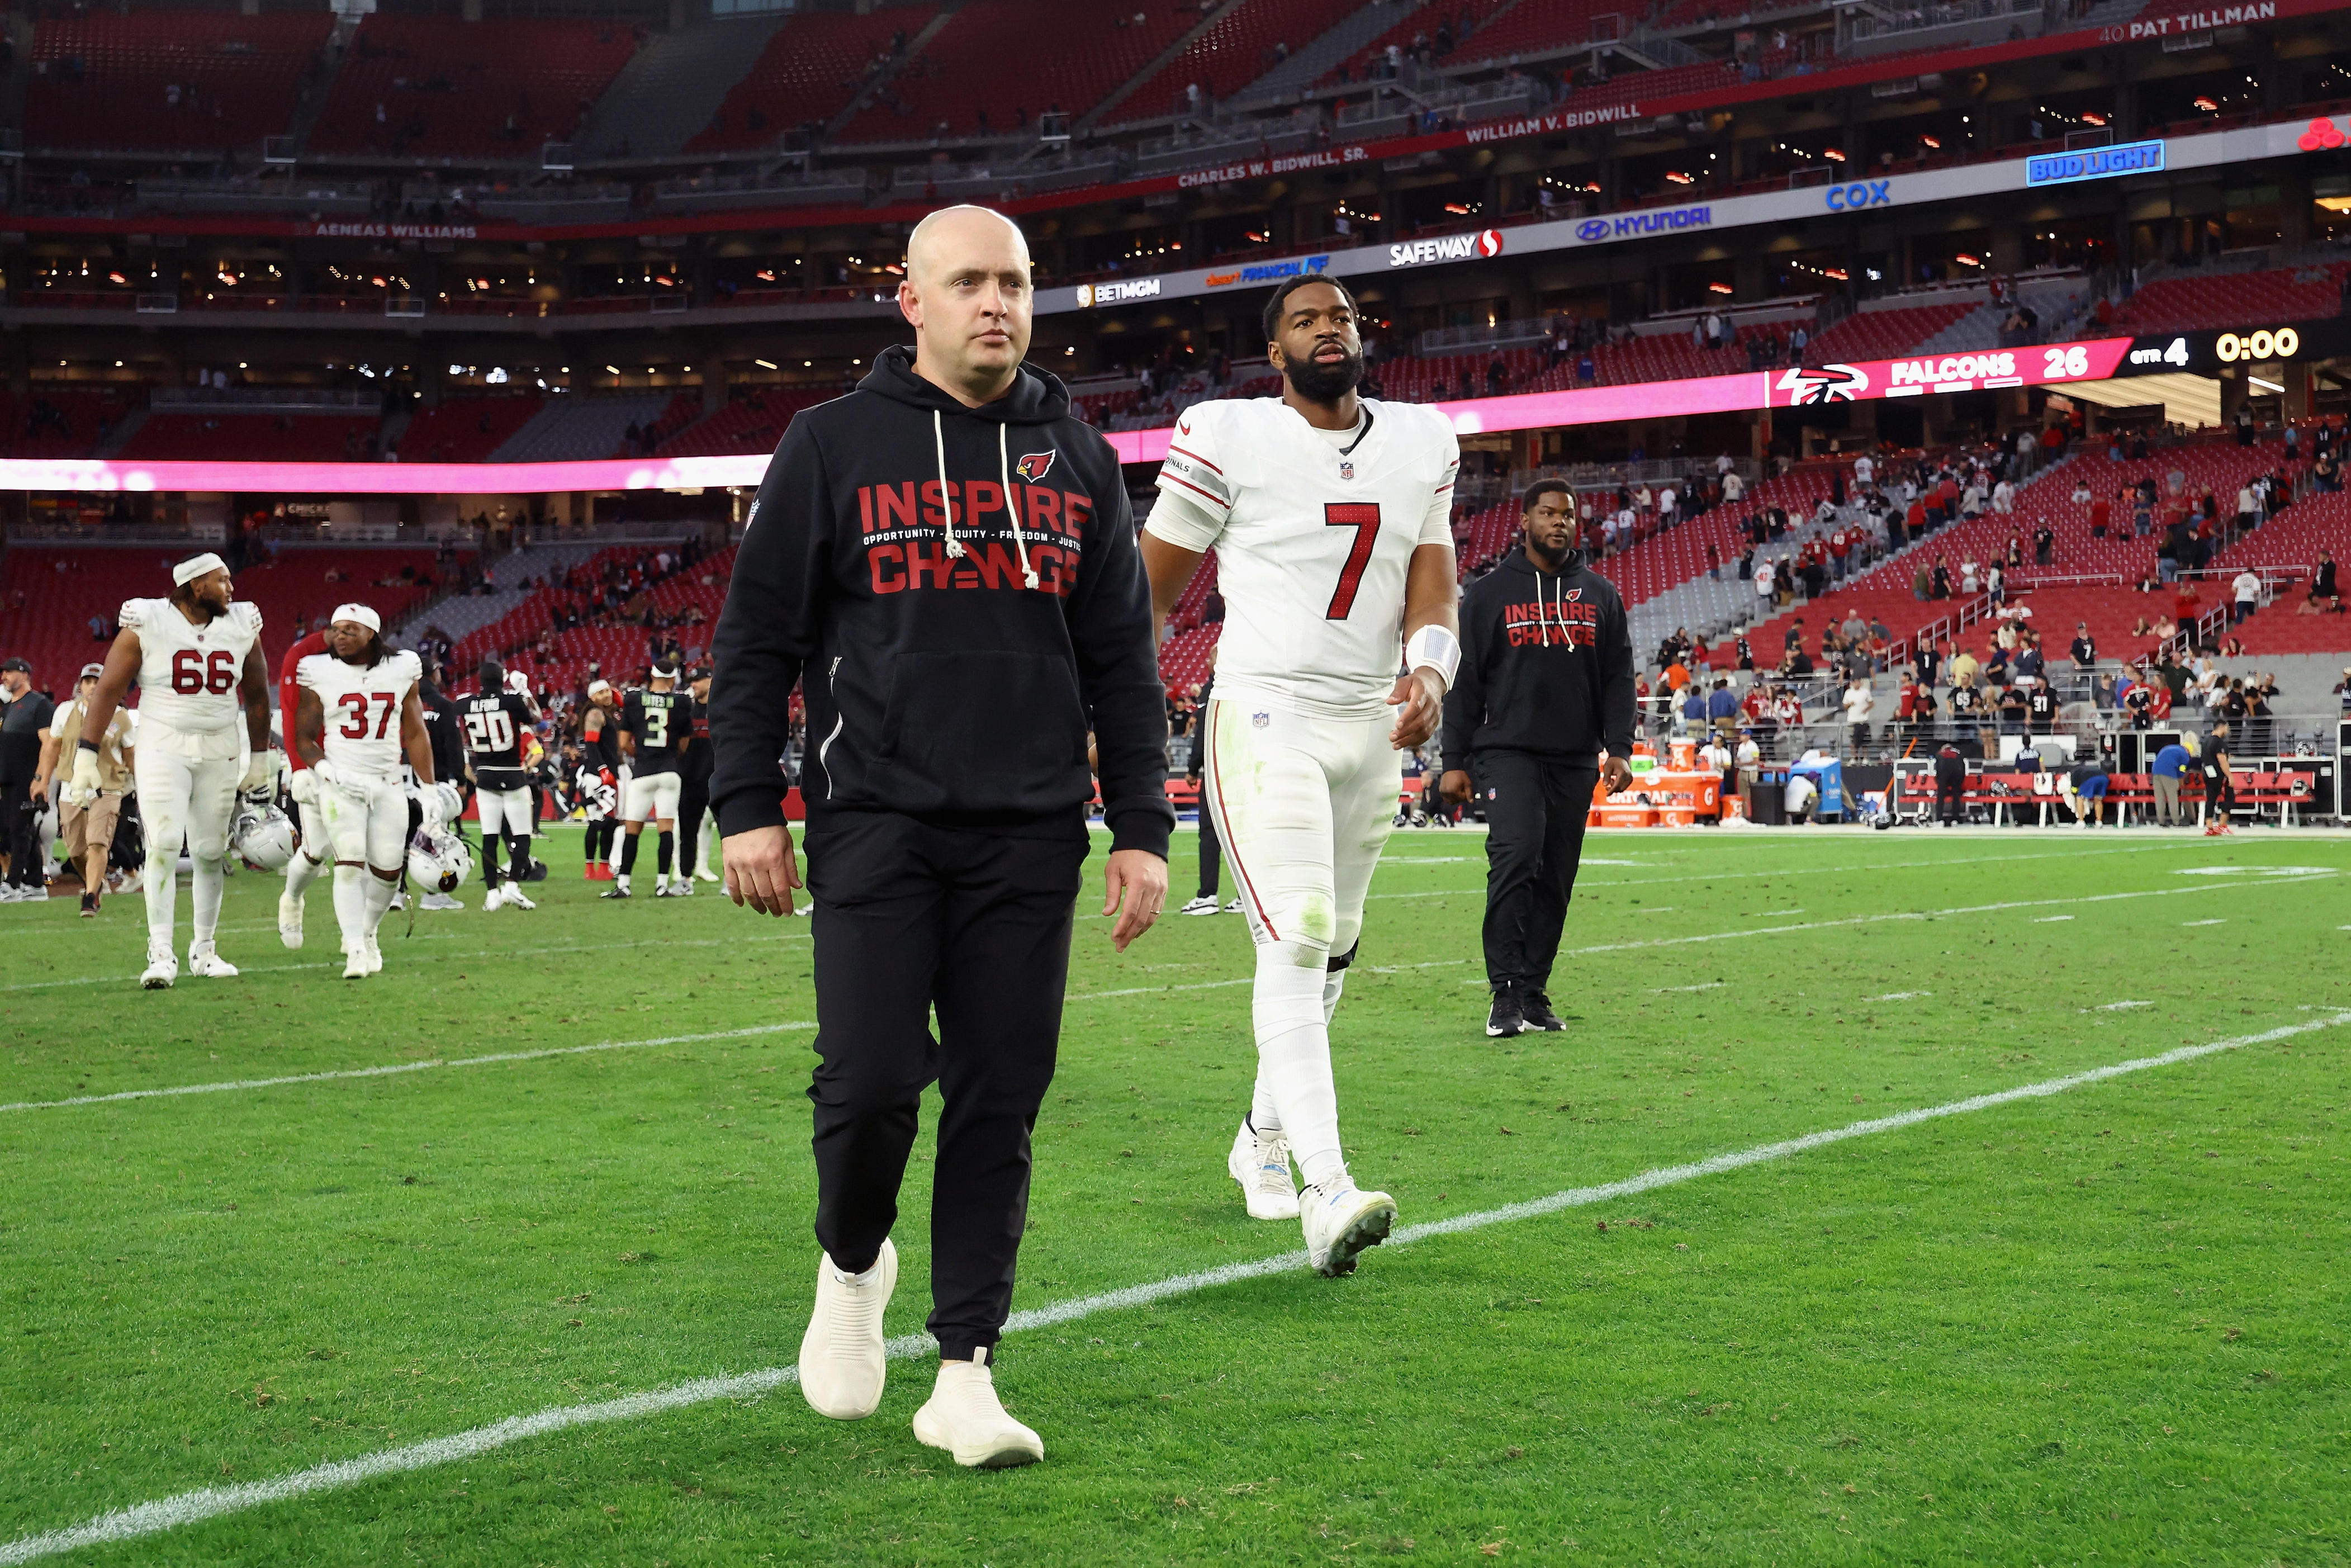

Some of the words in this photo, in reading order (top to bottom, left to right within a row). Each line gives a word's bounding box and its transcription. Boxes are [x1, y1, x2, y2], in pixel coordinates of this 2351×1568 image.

[2130, 18, 2170, 39] PAT
[2177, 1, 2276, 31] TILLMAN
[1466, 119, 1541, 144] WILLIAM
[1545, 116, 1562, 130] V.
[1566, 105, 1642, 128] BIDWILL
[1178, 166, 1246, 188] CHARLES
[1250, 163, 1269, 176] W.
[1272, 152, 1340, 173] BIDWILL,
[1344, 146, 1369, 162] SR.
[2031, 158, 2083, 181] BUD
[2084, 145, 2159, 174] LIGHT
[1826, 179, 1890, 211] COX
[316, 224, 387, 236] AENEAS
[391, 225, 476, 238] WILLIAMS
[1614, 207, 1711, 235] HYUNDAI
[1390, 234, 1477, 267] SAFEWAY
[1094, 278, 1161, 303] BETMGM
[1891, 352, 2016, 386] FALCONS
[2044, 347, 2088, 378] 26
[2164, 337, 2189, 367] 4
[2216, 327, 2299, 362] 0:00
[857, 480, 1092, 541] INSPIRE
[864, 529, 936, 546] OPPORTUNITY
[1059, 537, 1082, 552] JUSTIC
[868, 541, 1082, 598] CHANGE
[1324, 502, 1381, 620] 7
[1504, 601, 1597, 624] INSPIRE
[172, 650, 234, 695] 66
[338, 693, 395, 740] 37
[2033, 695, 2048, 713] 31
[463, 709, 514, 753] 20
[643, 706, 670, 748] 3
[1704, 787, 1714, 806] G
